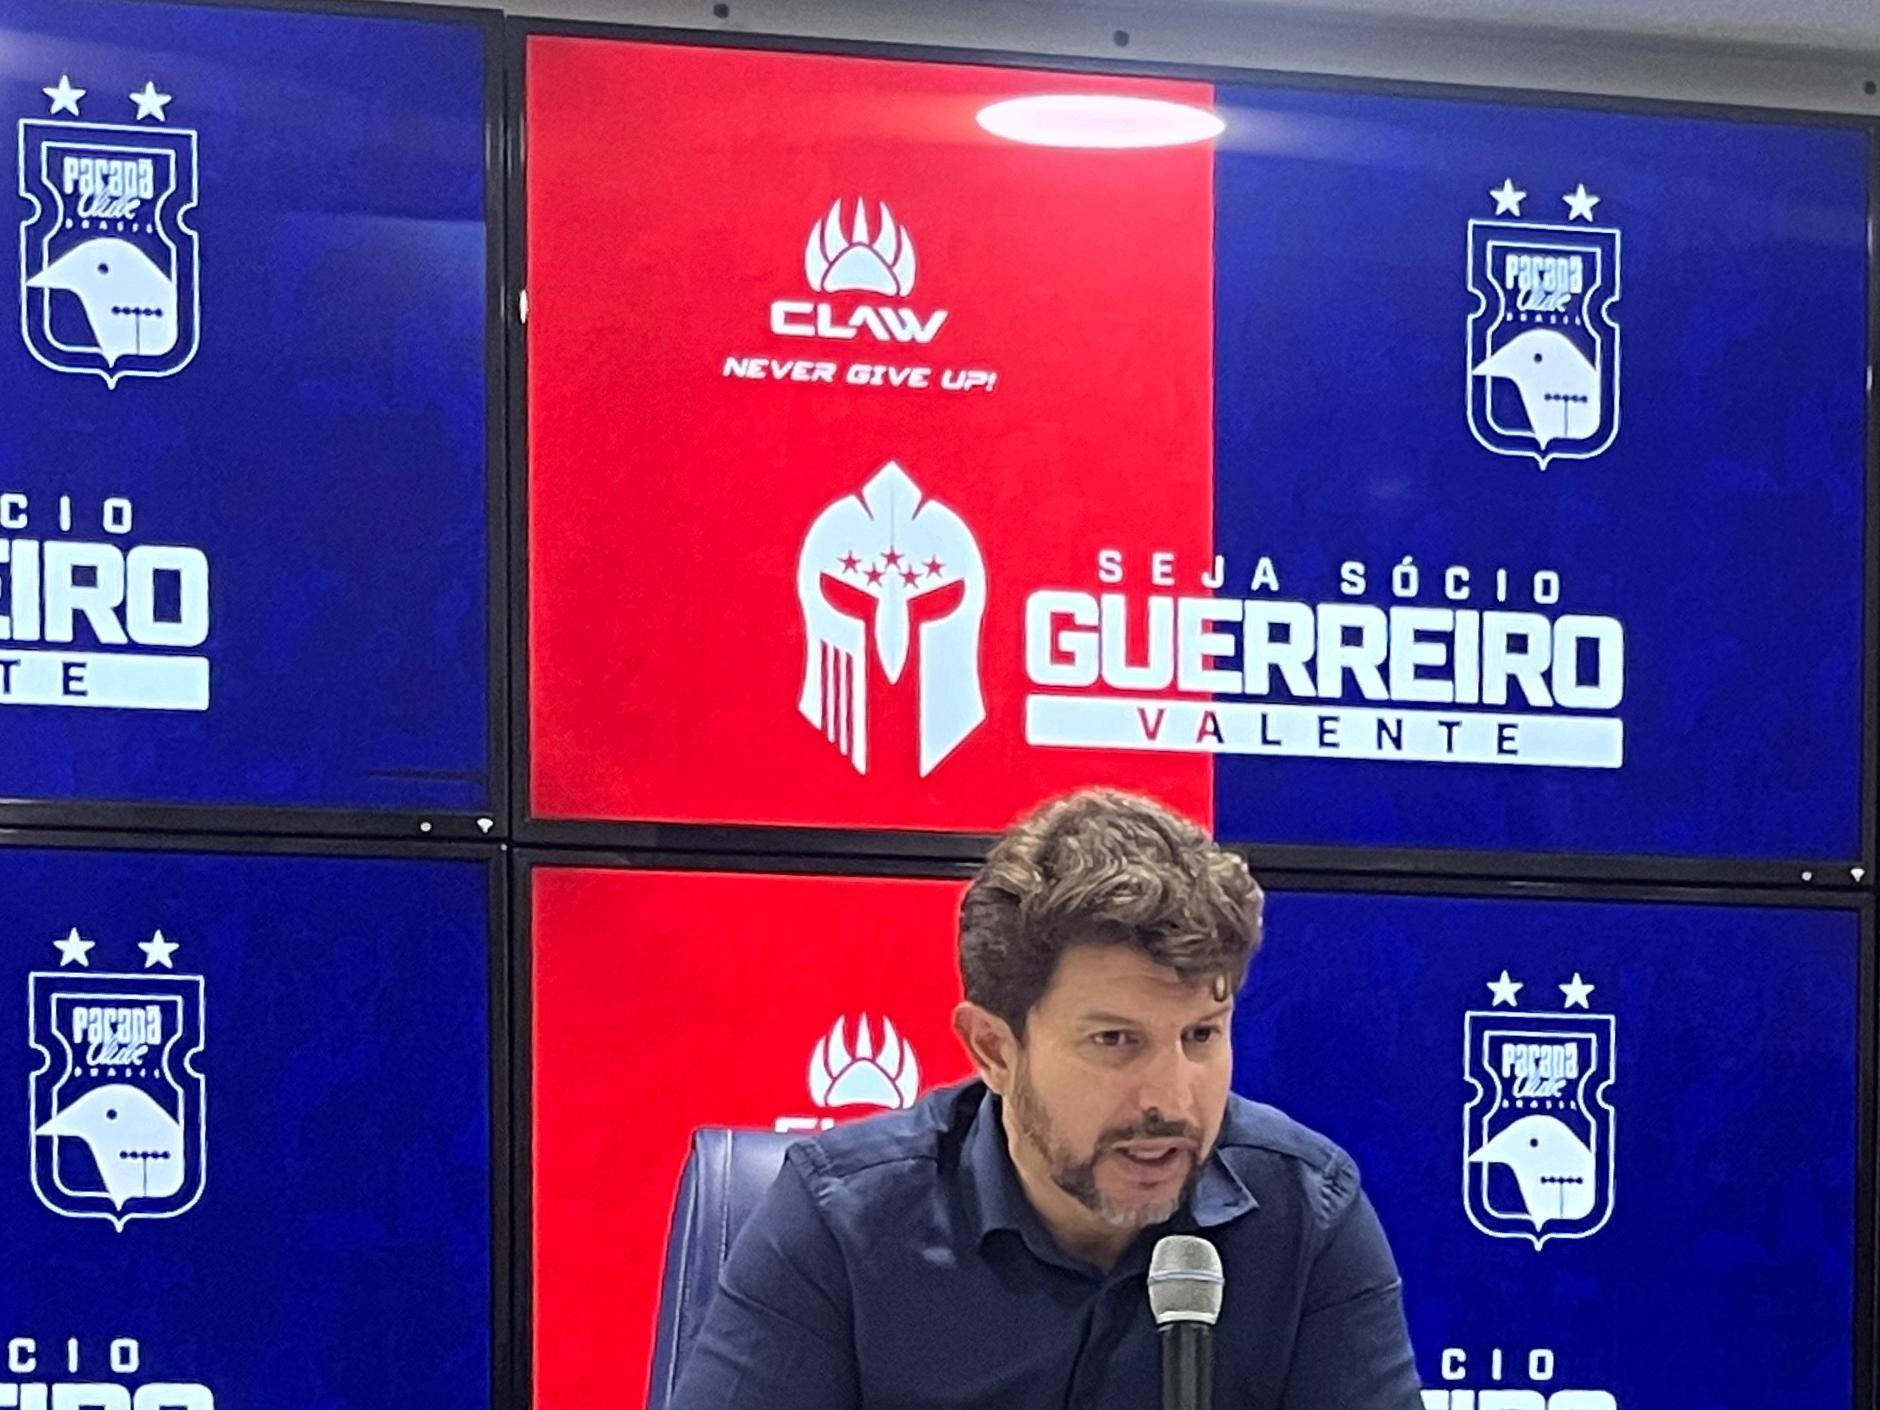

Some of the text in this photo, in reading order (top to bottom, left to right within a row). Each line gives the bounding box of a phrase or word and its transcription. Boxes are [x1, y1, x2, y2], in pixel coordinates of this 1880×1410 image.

[770, 300, 949, 343] CLAW
[723, 357, 998, 392] NEVER GIVE UP!
[0, 493, 133, 534] CIO
[1098, 549, 1561, 605] SEJA SÓCIO
[1025, 589, 1625, 710] GUERREIRO
[1136, 707, 1520, 756] VALENTE
[8, 1337, 140, 1374] CIO
[1441, 1348, 1555, 1381] CIO
